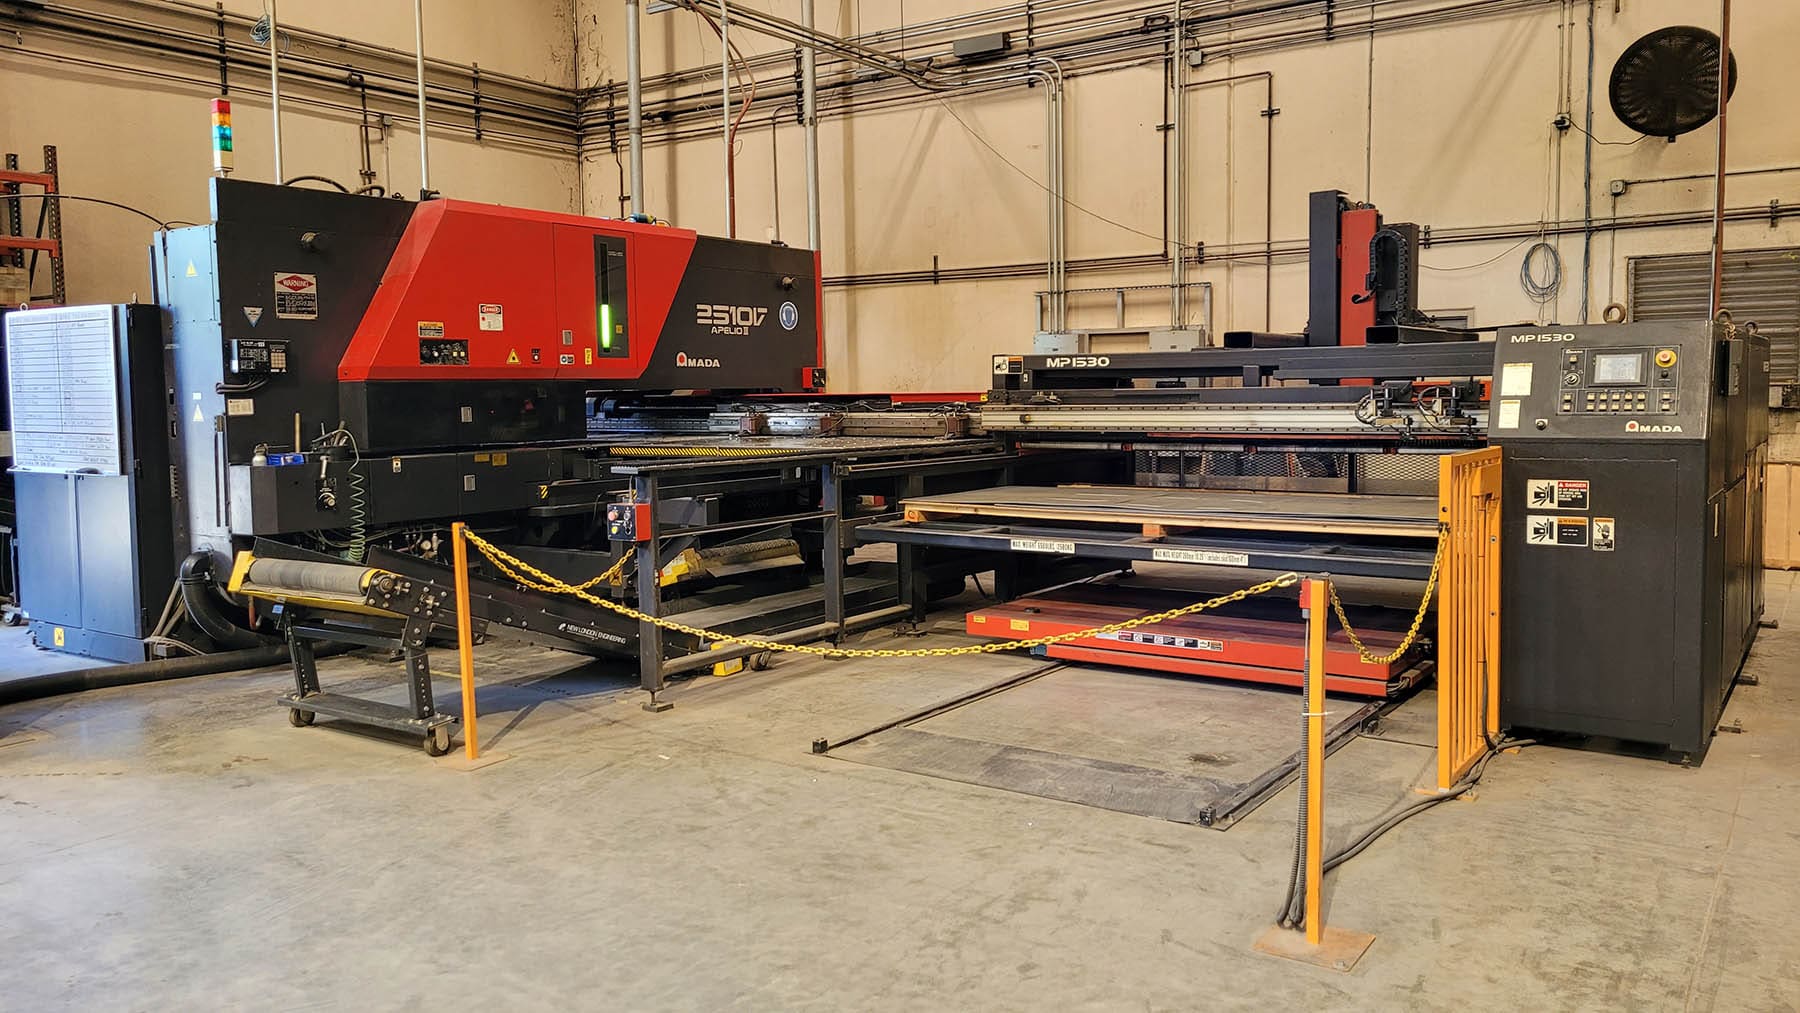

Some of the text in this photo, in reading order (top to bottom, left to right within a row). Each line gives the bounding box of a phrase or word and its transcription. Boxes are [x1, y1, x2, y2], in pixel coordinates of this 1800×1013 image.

[711, 326, 743, 335] APELIO
[676, 351, 720, 367] AMADA
[1625, 420, 1683, 432] AMADA
